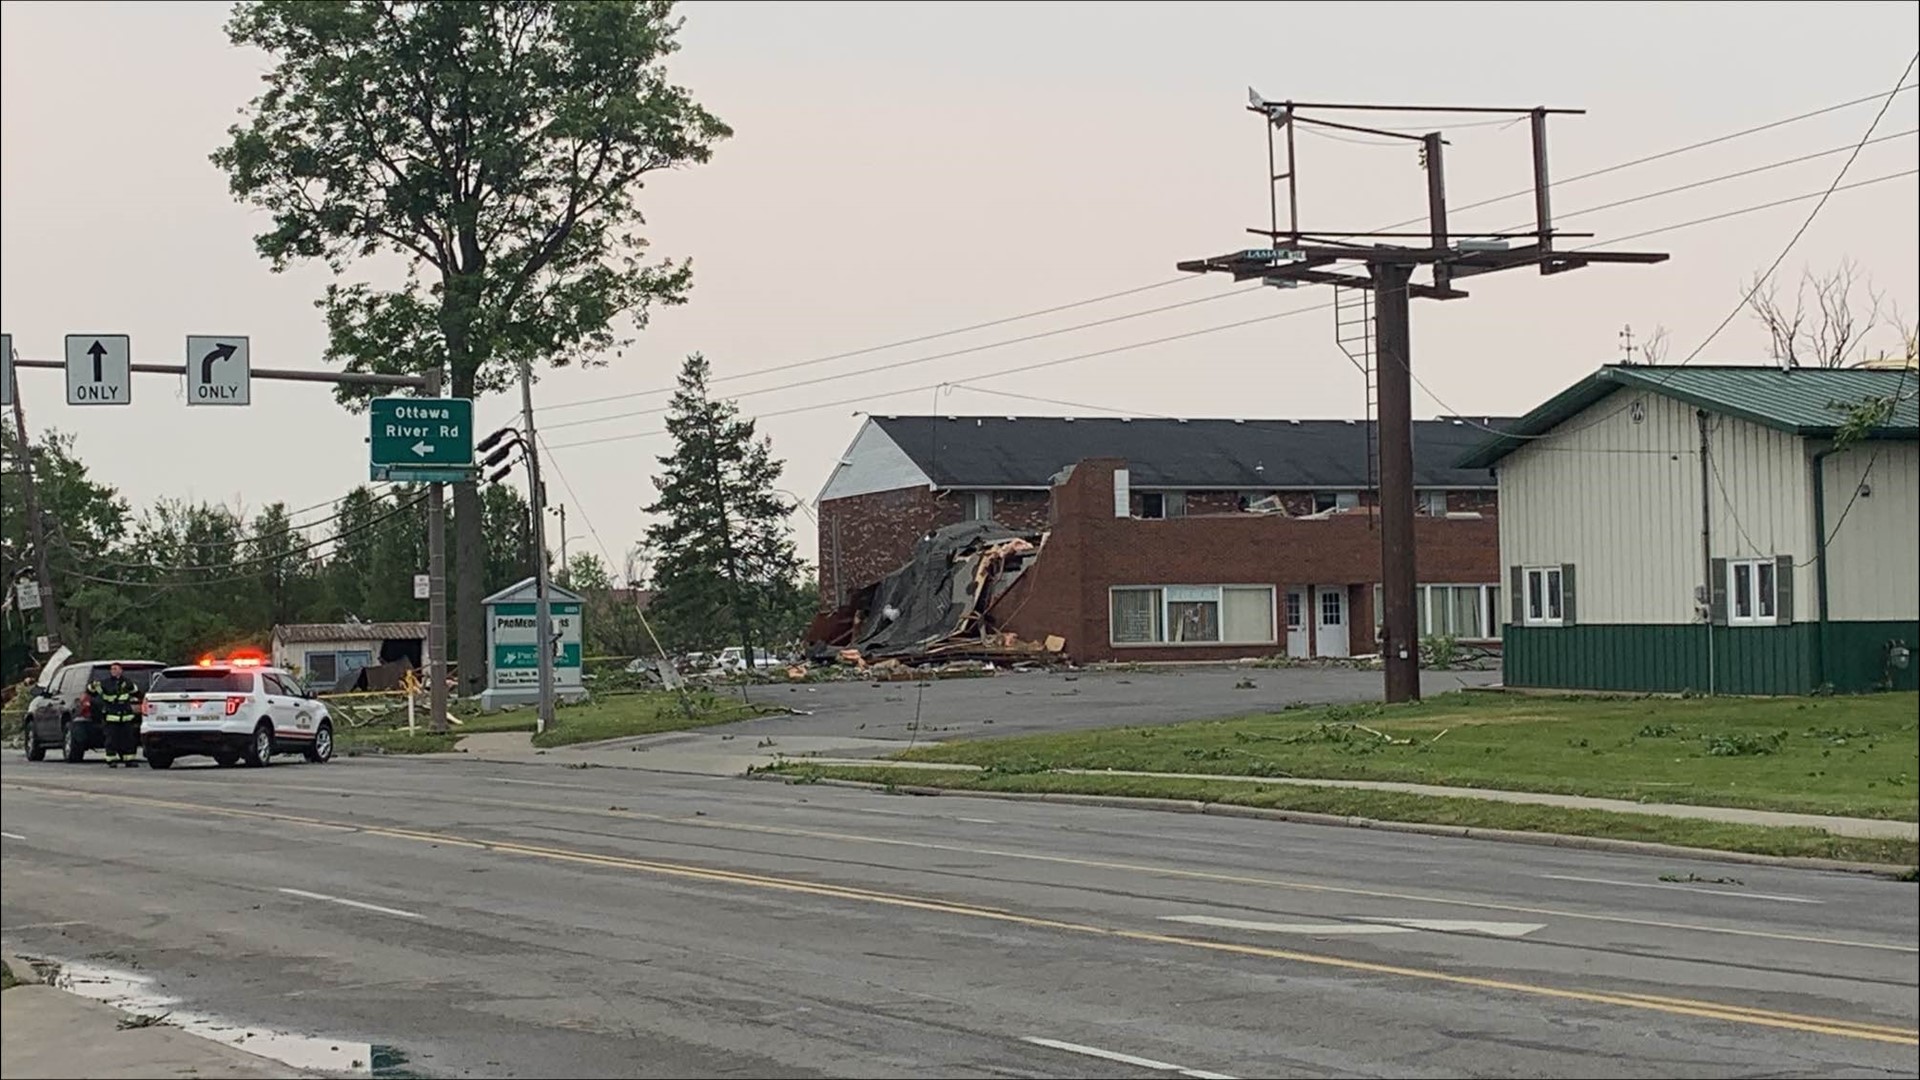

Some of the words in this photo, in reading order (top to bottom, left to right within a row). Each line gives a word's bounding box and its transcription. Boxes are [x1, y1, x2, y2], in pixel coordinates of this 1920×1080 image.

[76, 385, 119, 400] ONLY
[198, 385, 238, 399] ONLY
[395, 406, 450, 419] Ottawa
[386, 424, 430, 437] River
[440, 425, 459, 438] Rd
